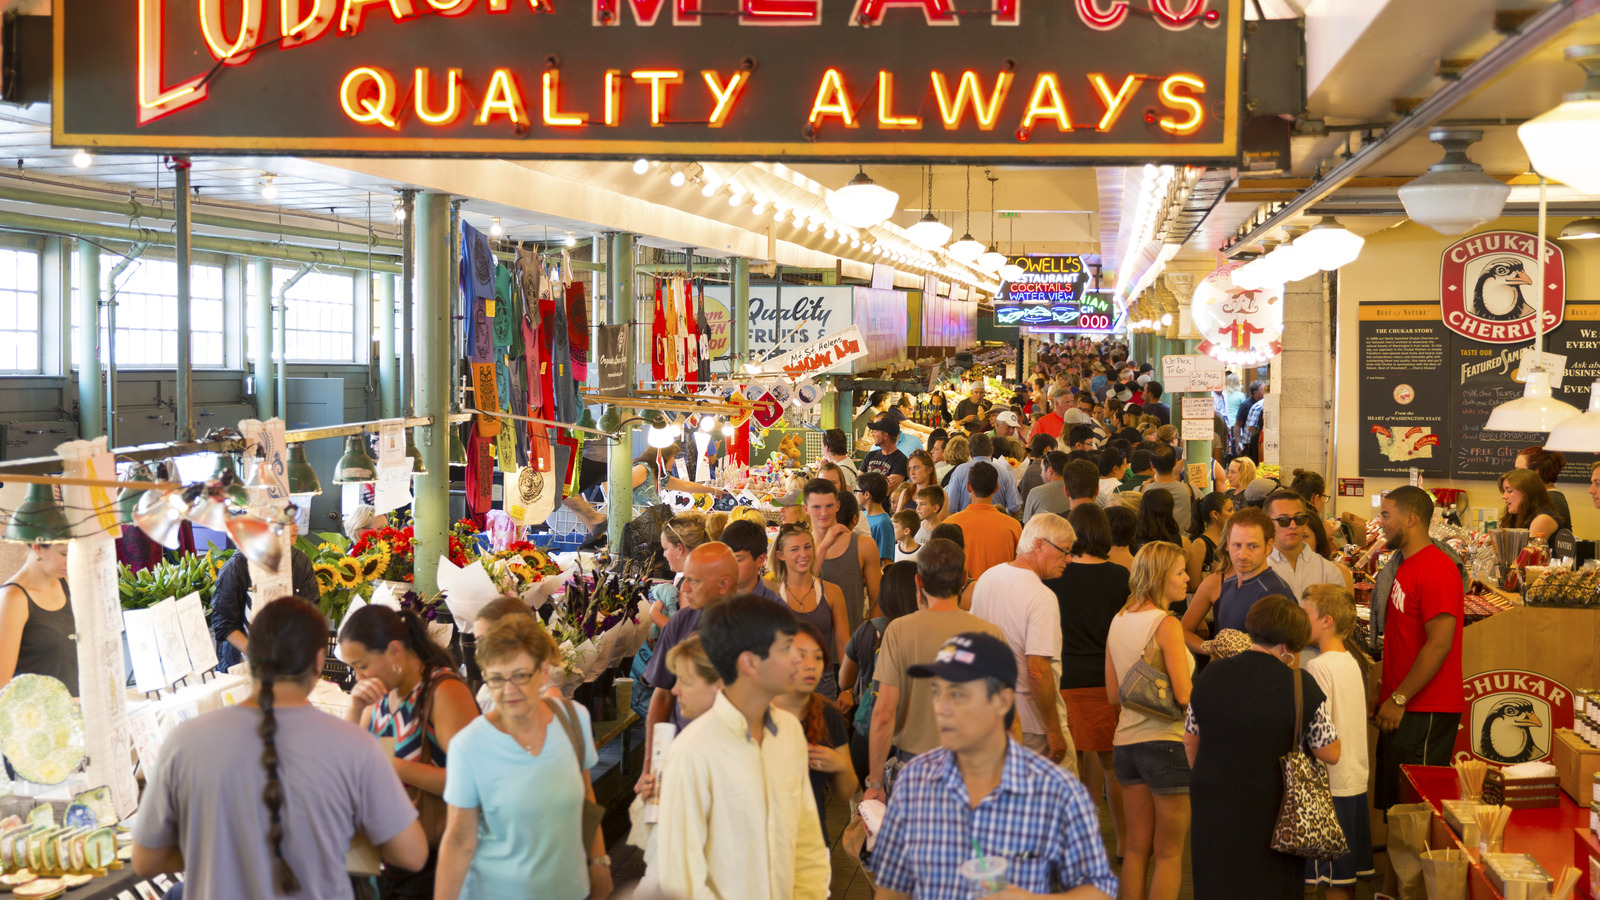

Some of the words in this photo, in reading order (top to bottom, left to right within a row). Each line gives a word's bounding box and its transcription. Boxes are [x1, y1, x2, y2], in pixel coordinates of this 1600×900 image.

[339, 66, 750, 129] QUALITY
[808, 67, 1205, 135] ALWAYS
[1451, 235, 1554, 264] CHUKAR
[1008, 256, 1081, 273] OWELL'S
[1008, 273, 1079, 283] ESTAURANT
[1010, 283, 1072, 292] COCKTAILS
[1009, 292, 1046, 301] WATER
[1048, 292, 1075, 301] VIEW
[1080, 295, 1108, 311] IAN
[749, 296, 832, 327] Quality
[1080, 305, 1095, 313] CH
[1080, 314, 1109, 328] OOD
[749, 328, 808, 343] FRUITS
[1580, 329, 1597, 338] WE
[709, 338, 727, 350] OU
[804, 347, 816, 357] St.
[818, 337, 843, 350] Helens
[833, 339, 860, 360] ASH
[1566, 341, 1600, 349] EVERY
[1461, 356, 1500, 385] FEATURED
[1571, 361, 1587, 369] Ask
[1563, 385, 1592, 394] EVEN
[1470, 447, 1494, 456] FREE
[1463, 674, 1565, 707] CHUKAR
